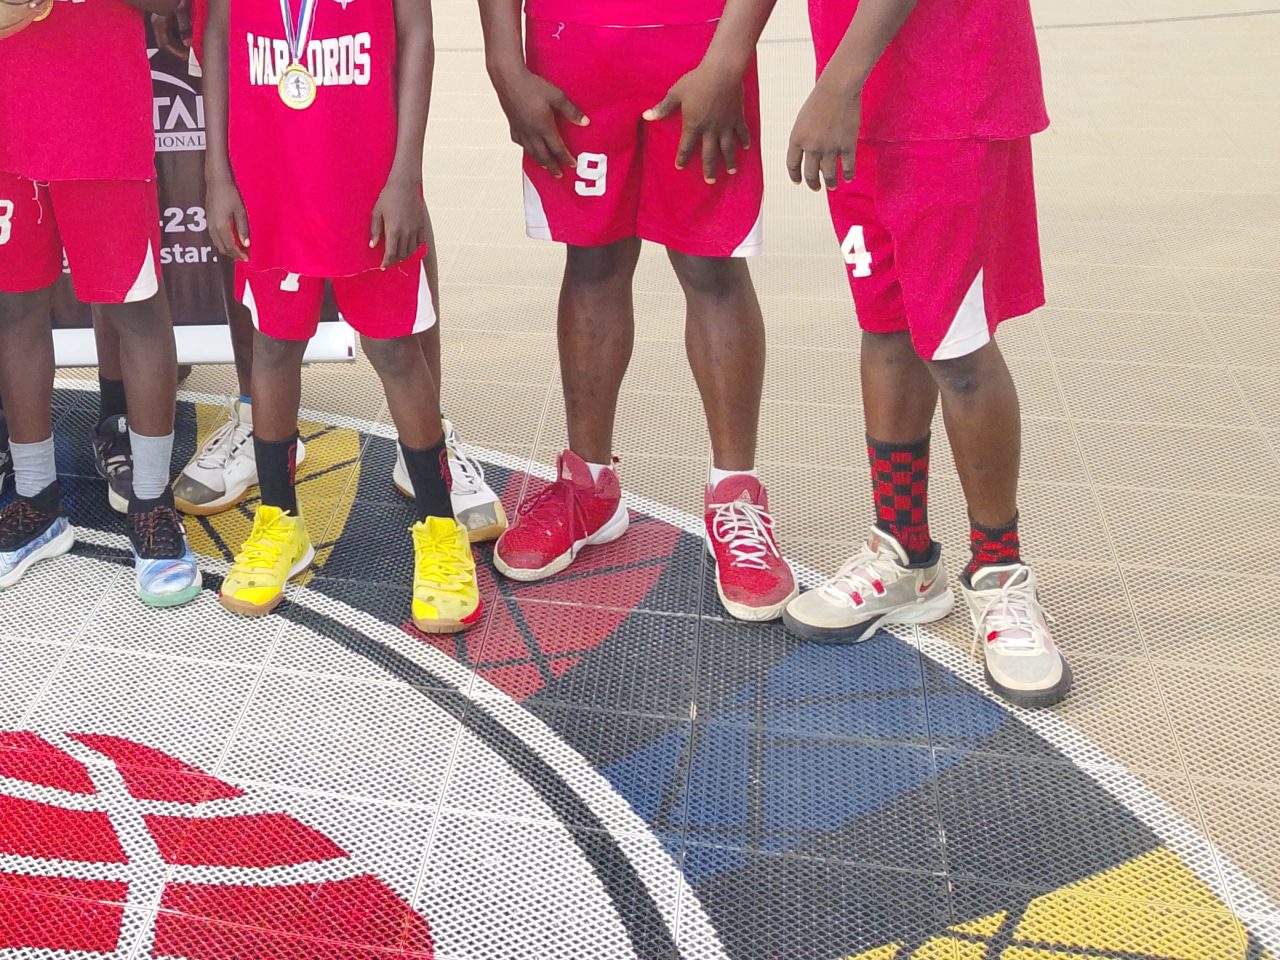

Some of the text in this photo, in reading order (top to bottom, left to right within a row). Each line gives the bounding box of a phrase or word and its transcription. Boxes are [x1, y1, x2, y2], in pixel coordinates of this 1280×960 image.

[246, 31, 372, 87] WARORDS
[574, 151, 608, 197] 9
[840, 224, 873, 278] 4
